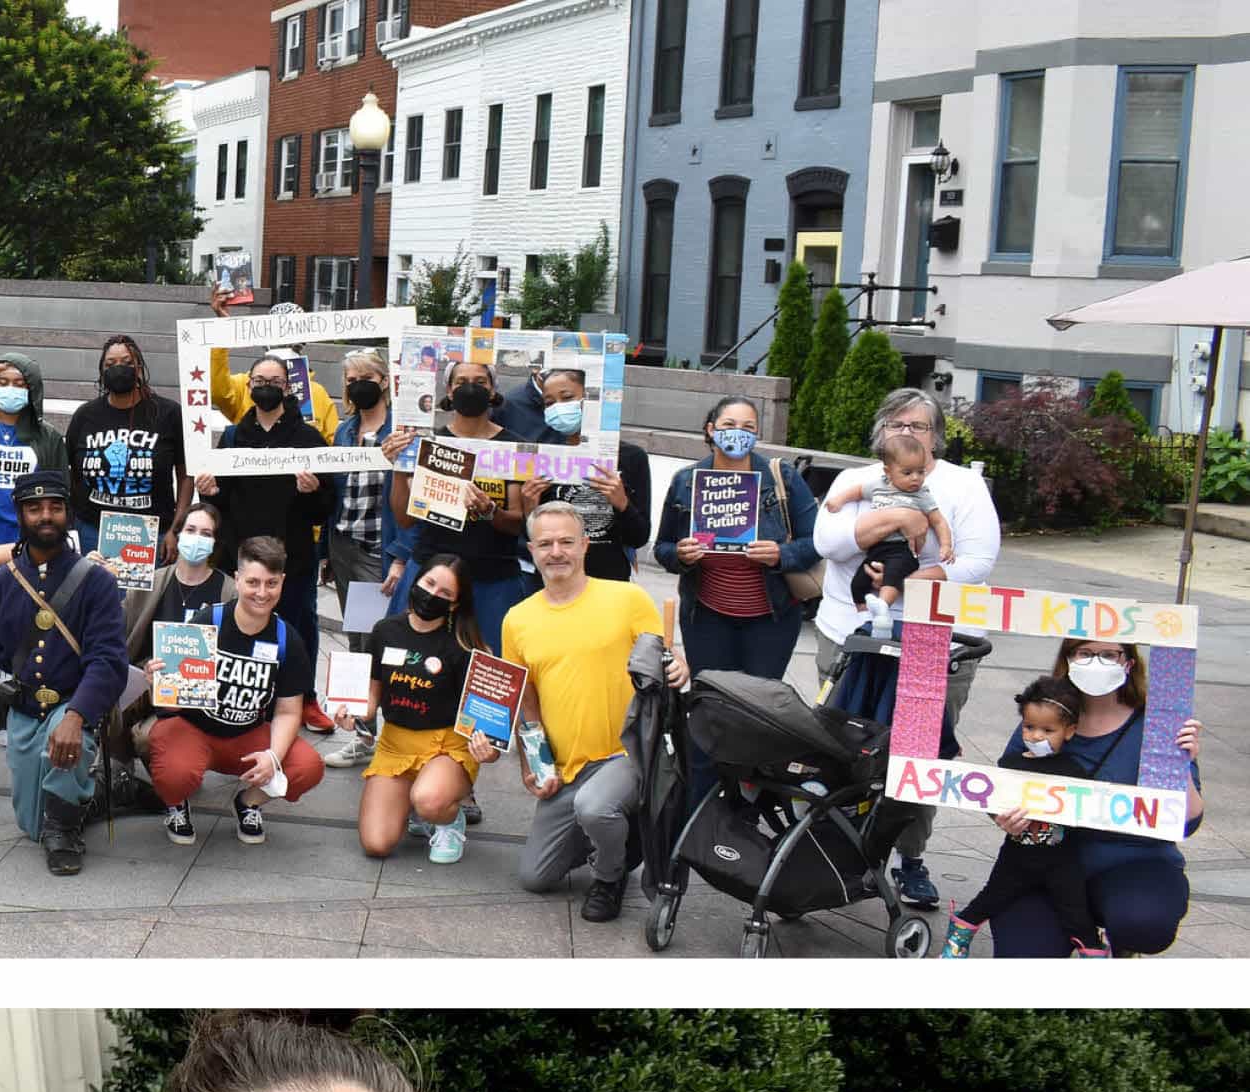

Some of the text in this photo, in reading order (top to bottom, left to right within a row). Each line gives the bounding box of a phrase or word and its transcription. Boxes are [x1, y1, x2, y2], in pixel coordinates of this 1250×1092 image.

[234, 318, 273, 343] TEACH
[278, 314, 328, 338] BANNED
[333, 312, 378, 335] BOOKS
[86, 429, 158, 449] MARCH
[431, 444, 465, 463] Teach
[130, 457, 153, 470] OUR
[428, 455, 465, 474] Power
[424, 475, 460, 494] TEACH
[704, 473, 741, 487] Teach
[423, 487, 458, 505] TRUTH
[702, 501, 750, 515] Change
[707, 515, 747, 528] Future
[106, 532, 141, 542] to Teach
[126, 549, 149, 558] Truth
[929, 582, 1142, 638] LET KIDS
[168, 634, 200, 646] pledge
[173, 645, 200, 656] Teach
[184, 663, 210, 674] Truth
[216, 655, 271, 689] EACH
